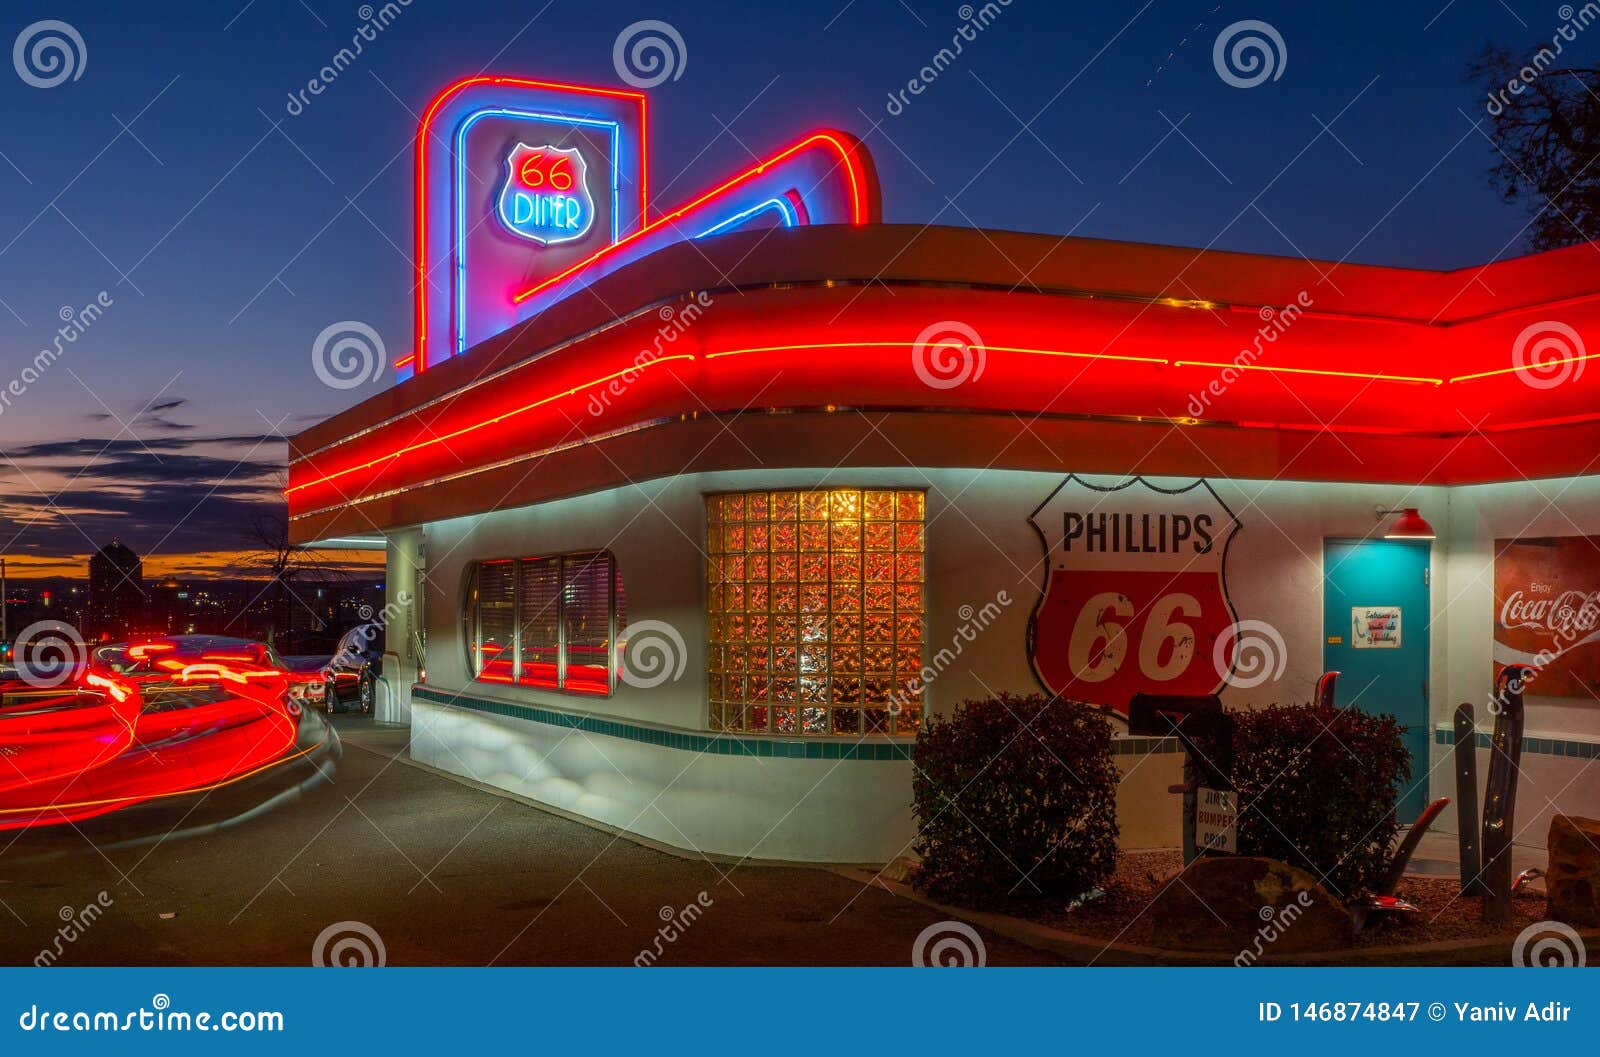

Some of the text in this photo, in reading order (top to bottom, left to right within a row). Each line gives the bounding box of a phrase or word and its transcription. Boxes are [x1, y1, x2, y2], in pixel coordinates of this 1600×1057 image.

[521, 153, 572, 191] 66
[513, 192, 580, 229] DINER
[1063, 511, 1213, 554] PHILLIPS
[1530, 582, 1552, 593] Enjoy
[1068, 592, 1202, 682] 66
[1198, 811, 1234, 828] BUMPER
[1204, 831, 1228, 848] CROP
